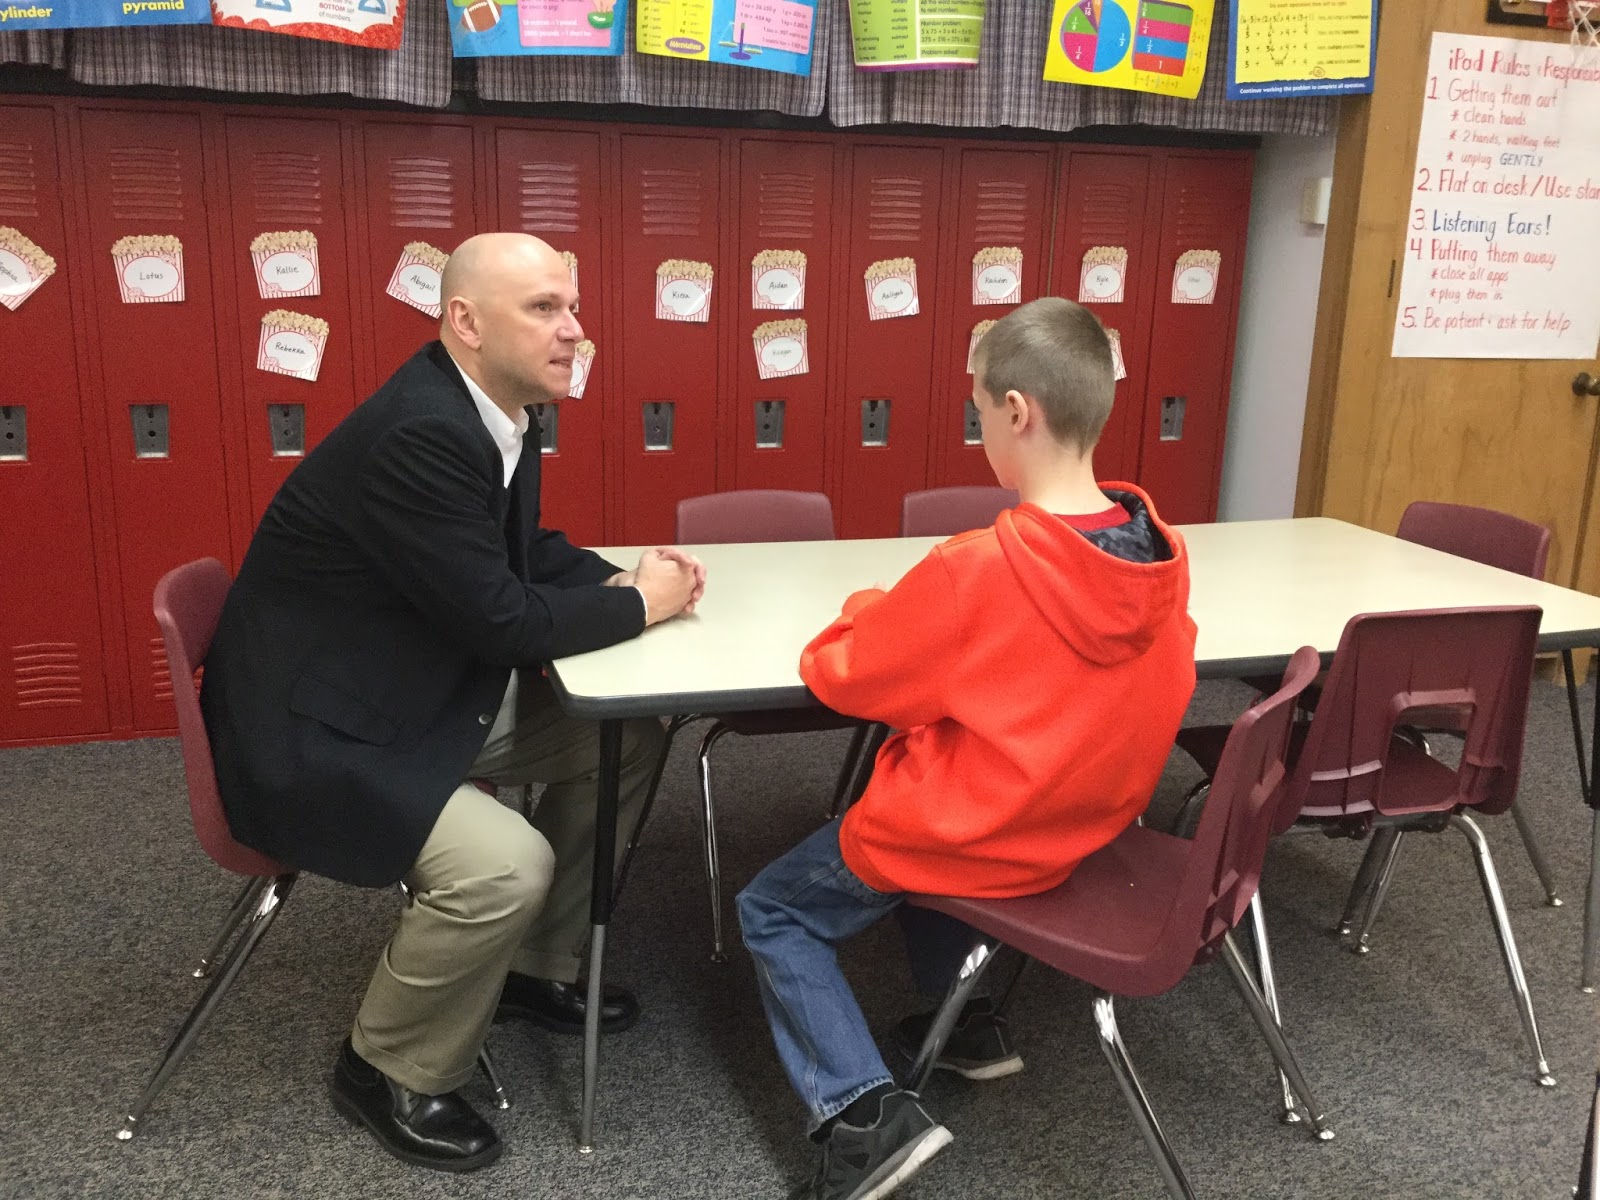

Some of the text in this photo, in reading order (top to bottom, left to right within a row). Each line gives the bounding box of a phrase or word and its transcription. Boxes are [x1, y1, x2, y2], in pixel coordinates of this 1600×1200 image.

[0, 5, 53, 22] ylinder
[123, 0, 185, 14] pyramid
[319, 2, 345, 12] BOTTOM
[1449, 48, 1484, 72] iPod
[1491, 50, 1530, 77] Rules
[1263, 86, 1282, 94] working
[1292, 84, 1310, 92] problem
[1448, 78, 1495, 110] Getting
[1501, 83, 1531, 106] them
[1536, 92, 1557, 108] out
[1500, 110, 1526, 126] hands
[1507, 135, 1538, 152] walking
[1543, 136, 1560, 148] feet
[1461, 152, 1544, 170] unplug GENTLY
[1438, 169, 1469, 193] Flat
[1473, 181, 1488, 194] on
[1432, 209, 1497, 242] Listening
[1507, 212, 1552, 236] Ears!
[1431, 238, 1478, 270] Putting
[1488, 241, 1518, 263] them
[1523, 250, 1557, 272] away
[139, 272, 164, 281] Lotus
[275, 265, 300, 276] Kallie
[1440, 264, 1509, 287] close all apps
[410, 274, 436, 293] Abigail
[768, 281, 788, 290] Aidan
[1096, 274, 1110, 286] Kyle
[1438, 288, 1461, 304] plug
[1467, 288, 1488, 300] them
[1424, 306, 1441, 328] Be
[1444, 310, 1485, 334] patient
[1496, 313, 1518, 330] ask
[1522, 311, 1538, 330] for
[1543, 310, 1571, 338] help
[274, 341, 306, 355] Rebekka
